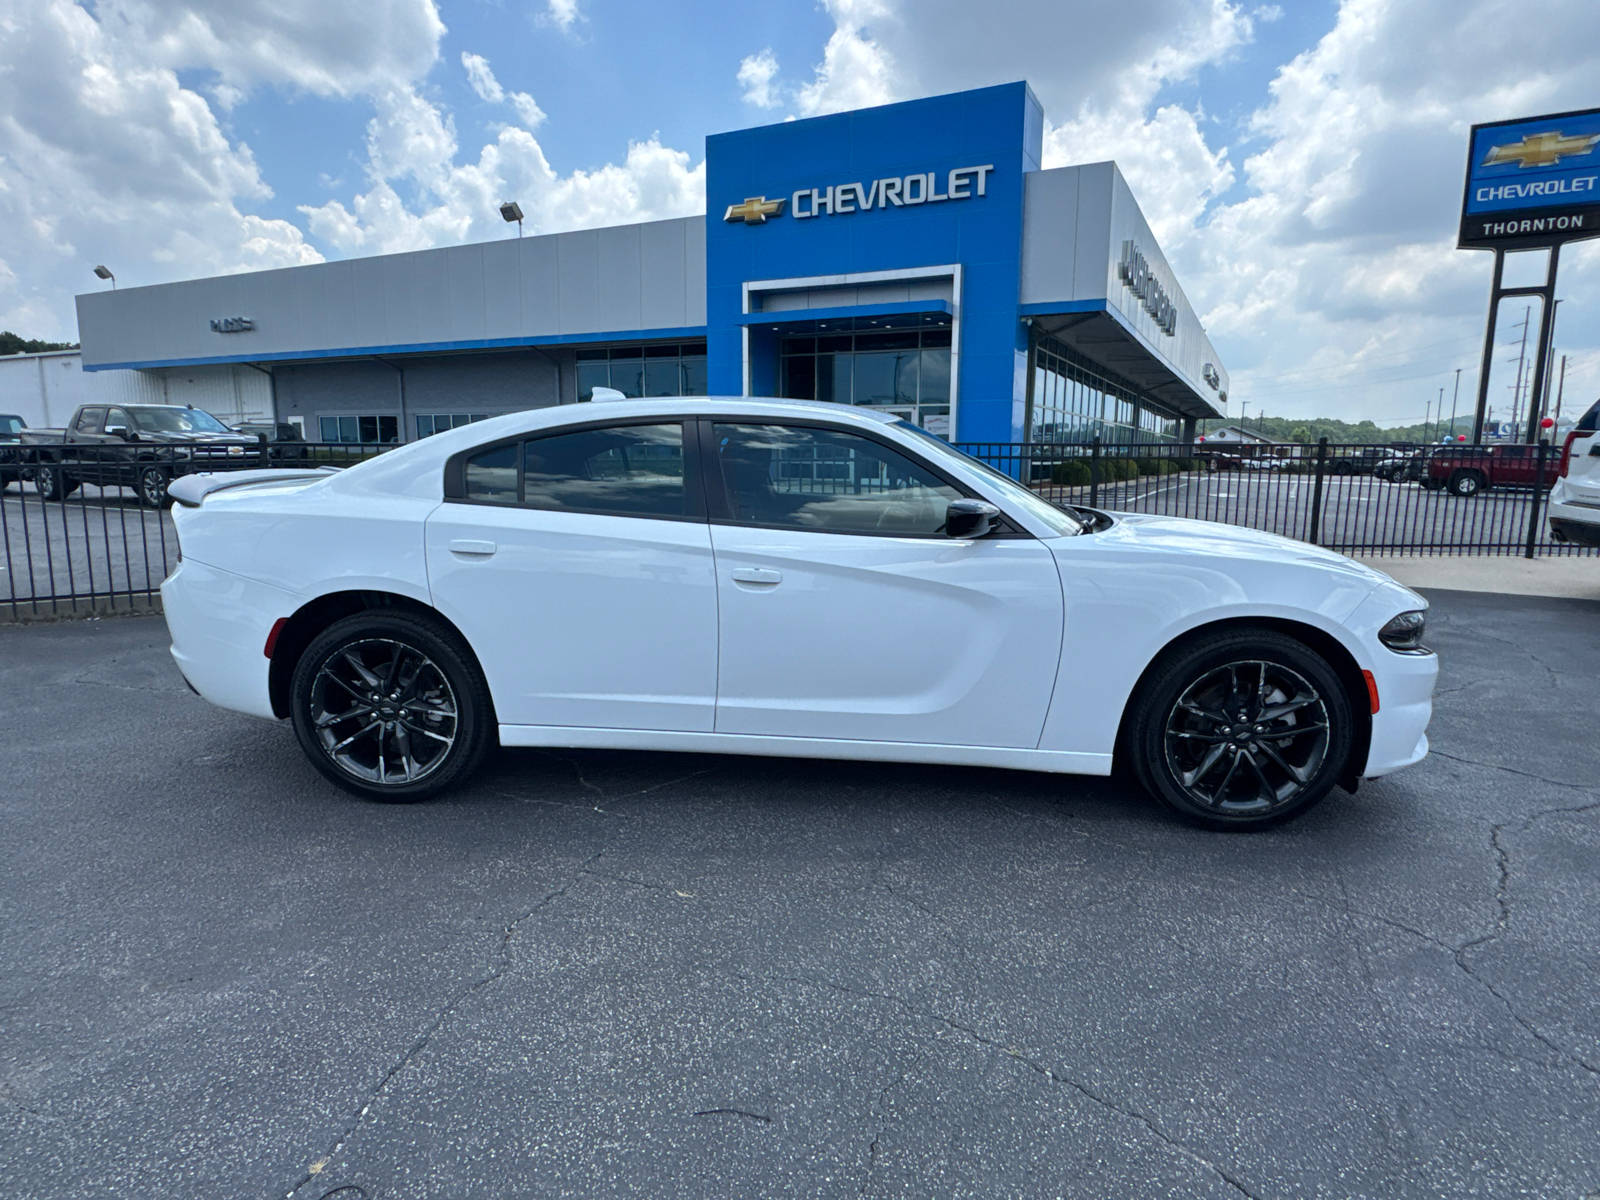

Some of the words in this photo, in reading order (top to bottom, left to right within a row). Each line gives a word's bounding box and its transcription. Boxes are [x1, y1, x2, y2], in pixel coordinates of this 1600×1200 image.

[792, 164, 993, 218] CHEVROLET
[1476, 176, 1598, 201] CHEVROLET
[1482, 215, 1583, 235] THORNTON
